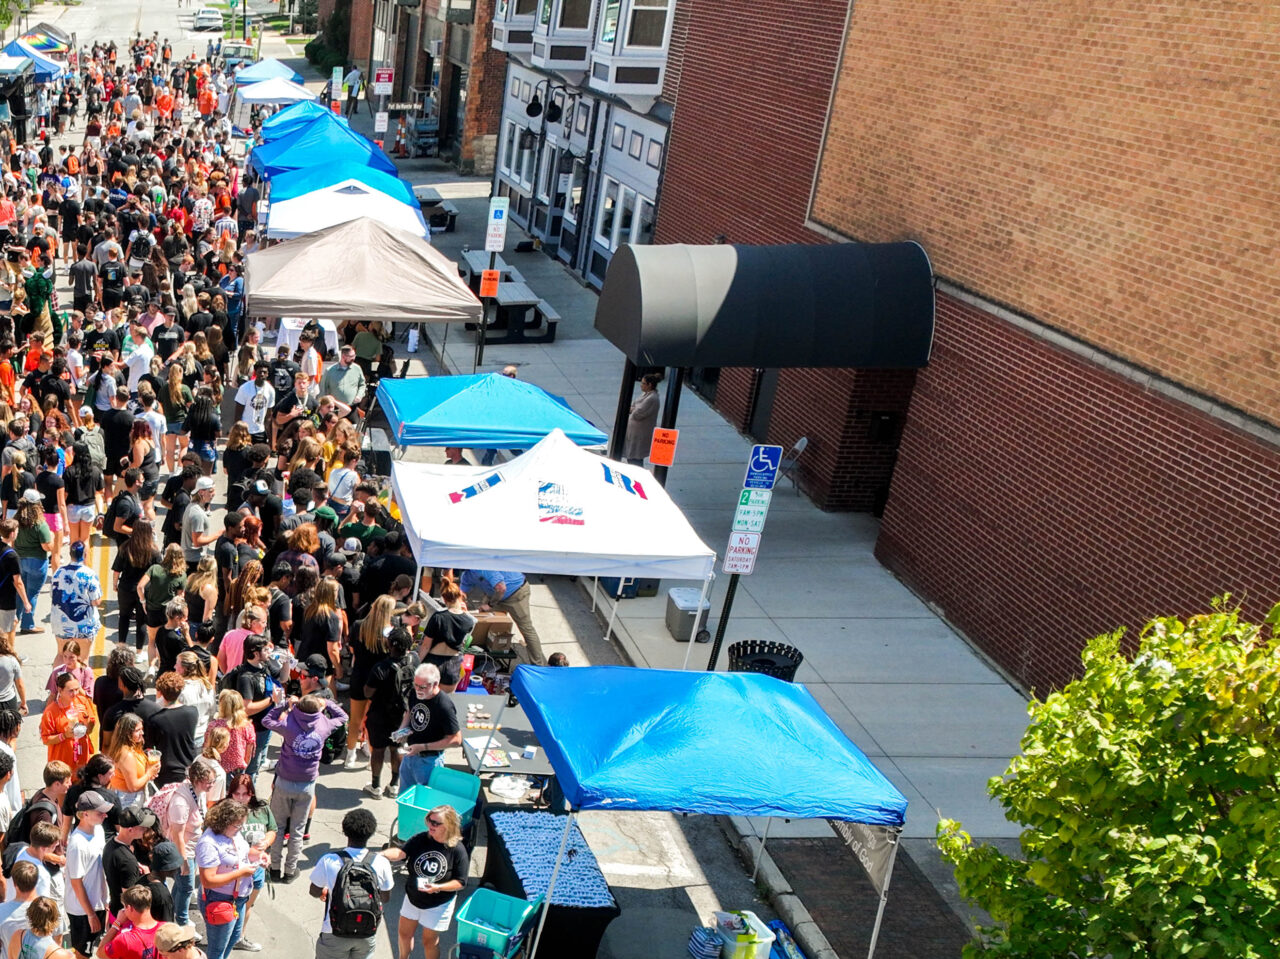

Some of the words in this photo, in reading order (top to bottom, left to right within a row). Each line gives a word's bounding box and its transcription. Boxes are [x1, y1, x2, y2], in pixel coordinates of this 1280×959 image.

[654, 438, 676, 446] PARKING
[741, 492, 749, 503] 2
[738, 537, 751, 546] NO
[728, 545, 756, 555] PARKING
[423, 860, 439, 874] NB
